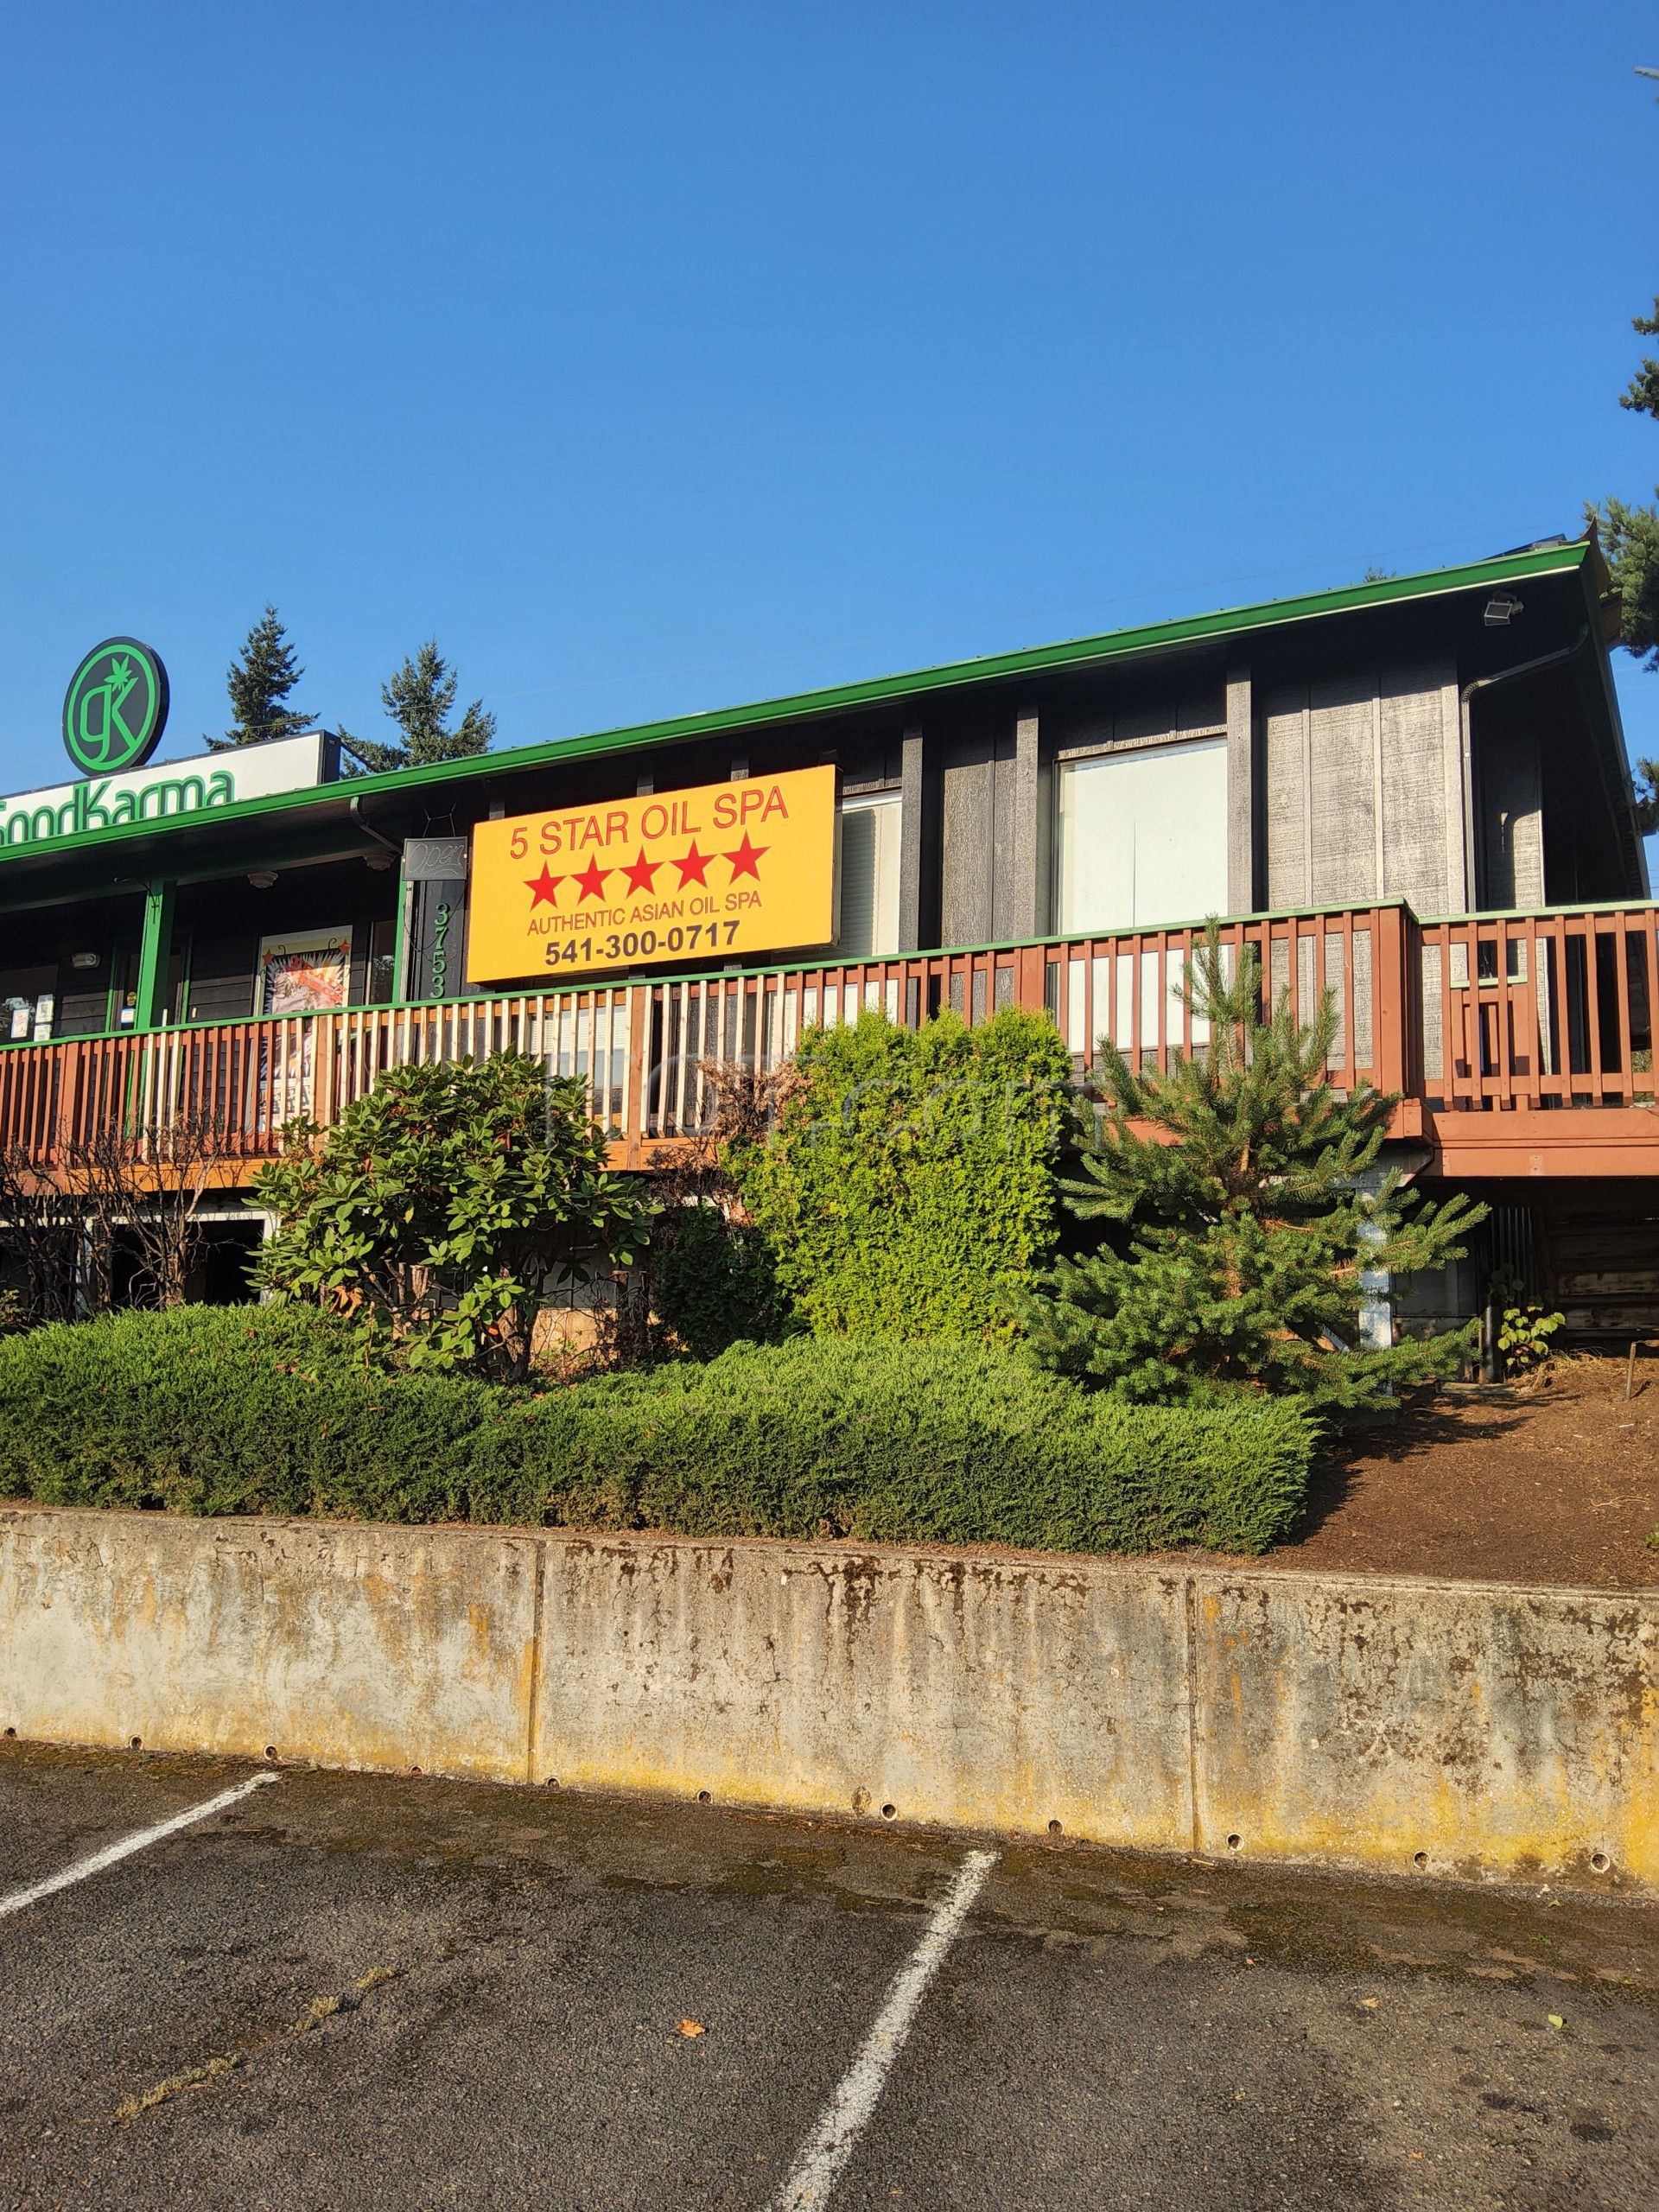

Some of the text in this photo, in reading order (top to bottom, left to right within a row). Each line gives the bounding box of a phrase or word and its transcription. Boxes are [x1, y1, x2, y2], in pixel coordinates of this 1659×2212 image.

[510, 785, 789, 860] 5 STAR OIL SPA
[407, 843, 465, 874] Open
[527, 890, 762, 936] AUTHENTIC ASIAN OIL SPA
[429, 904, 451, 1000] 3753
[545, 919, 741, 966] 541-300-0717
